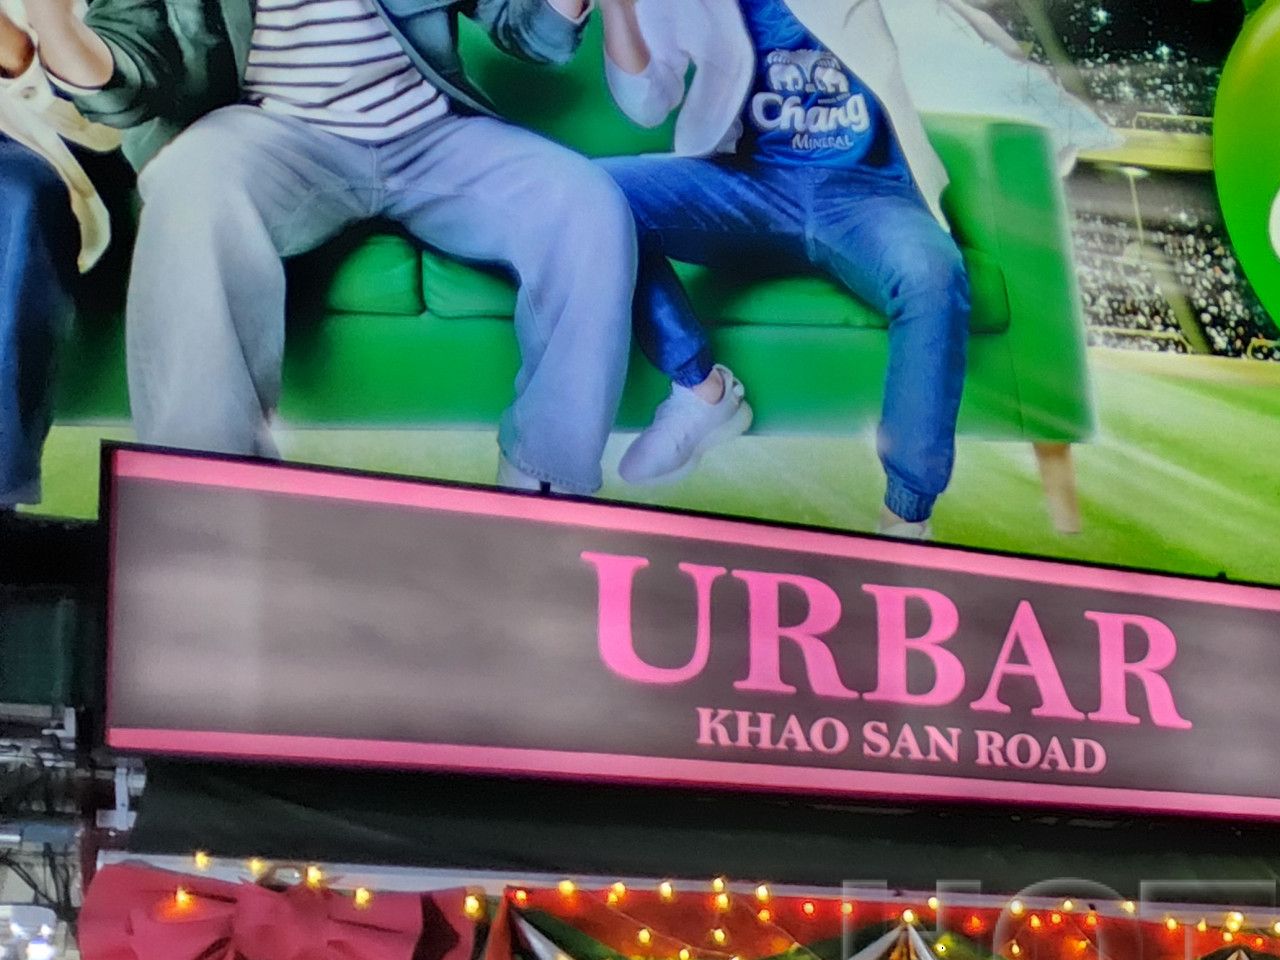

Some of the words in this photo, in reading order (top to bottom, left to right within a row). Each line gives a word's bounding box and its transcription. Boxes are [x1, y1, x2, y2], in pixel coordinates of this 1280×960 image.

[753, 92, 869, 132] Chang
[791, 133, 853, 151] MINERAL
[580, 551, 1193, 730] URBAR
[696, 707, 849, 754] KHAO
[862, 721, 962, 763] SAN
[974, 730, 1107, 775] ROAD
